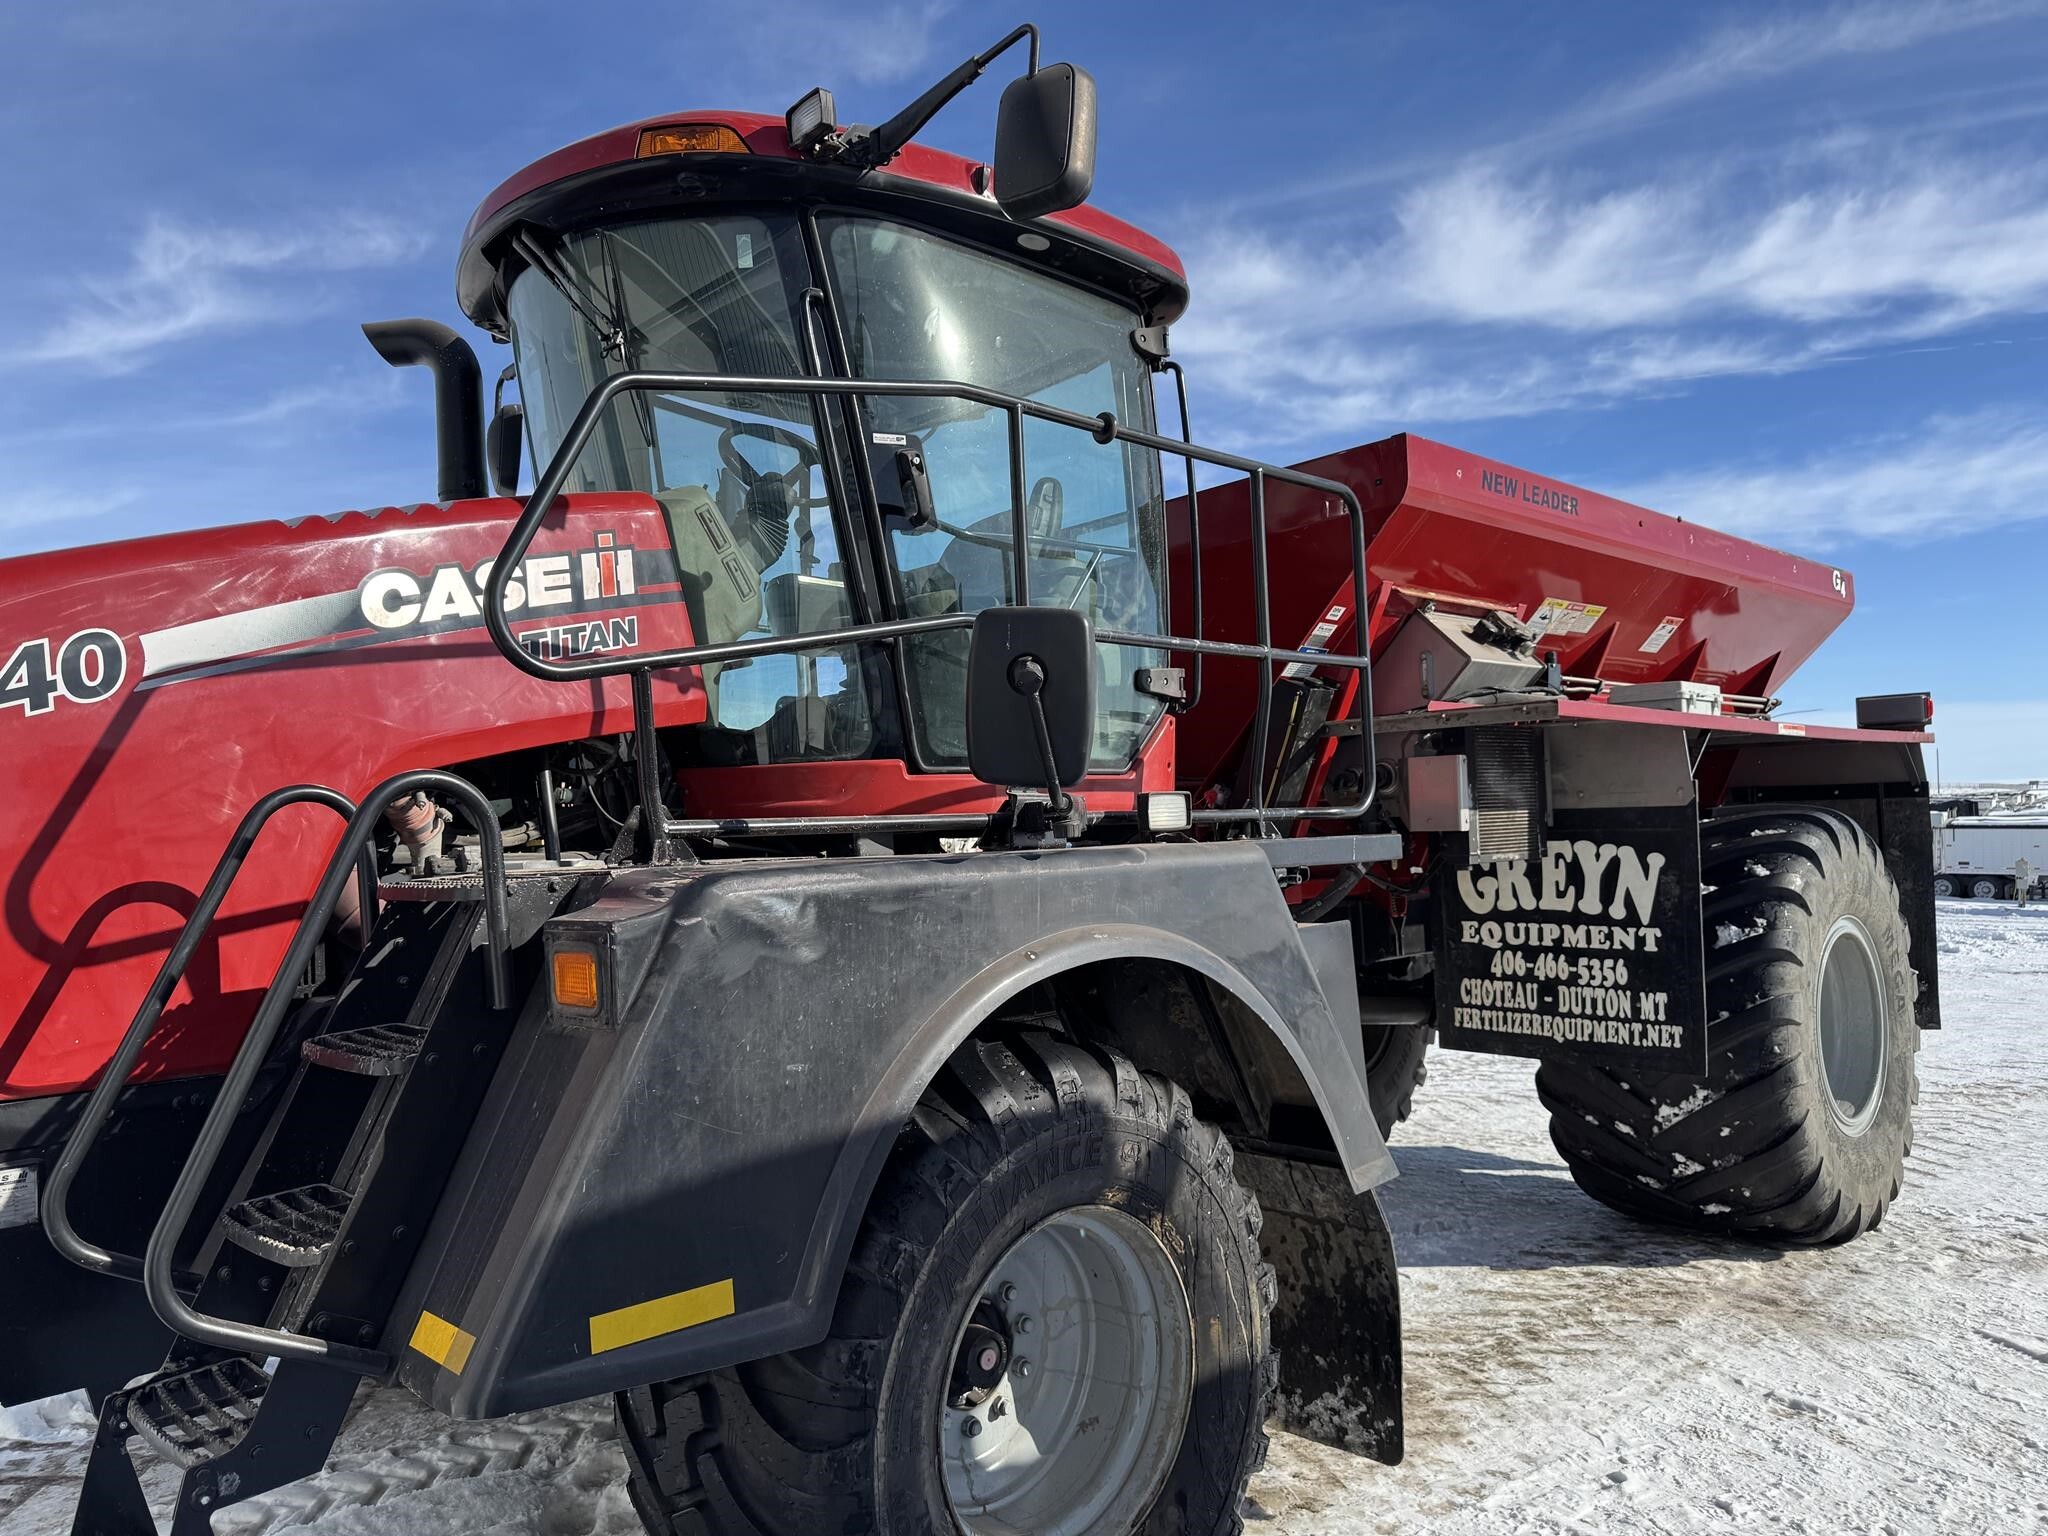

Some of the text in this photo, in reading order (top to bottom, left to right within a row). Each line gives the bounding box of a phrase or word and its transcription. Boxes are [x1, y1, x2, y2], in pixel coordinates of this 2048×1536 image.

[1481, 470, 1579, 516] NEW LEADER
[360, 553, 573, 629] CASE
[518, 615, 638, 661] TITAN
[0, 627, 127, 718] 40
[1456, 839, 1666, 926] GREYN
[1460, 920, 1662, 952] EQUIPMENT
[1490, 949, 1629, 988] 406-466-5356
[1459, 977, 1539, 1010] CHOTEAU
[1557, 985, 1632, 1021] DUTTON
[1639, 992, 1668, 1022] MT
[1453, 1006, 1683, 1049] FERTILIZEREQUIPMENT.NET
